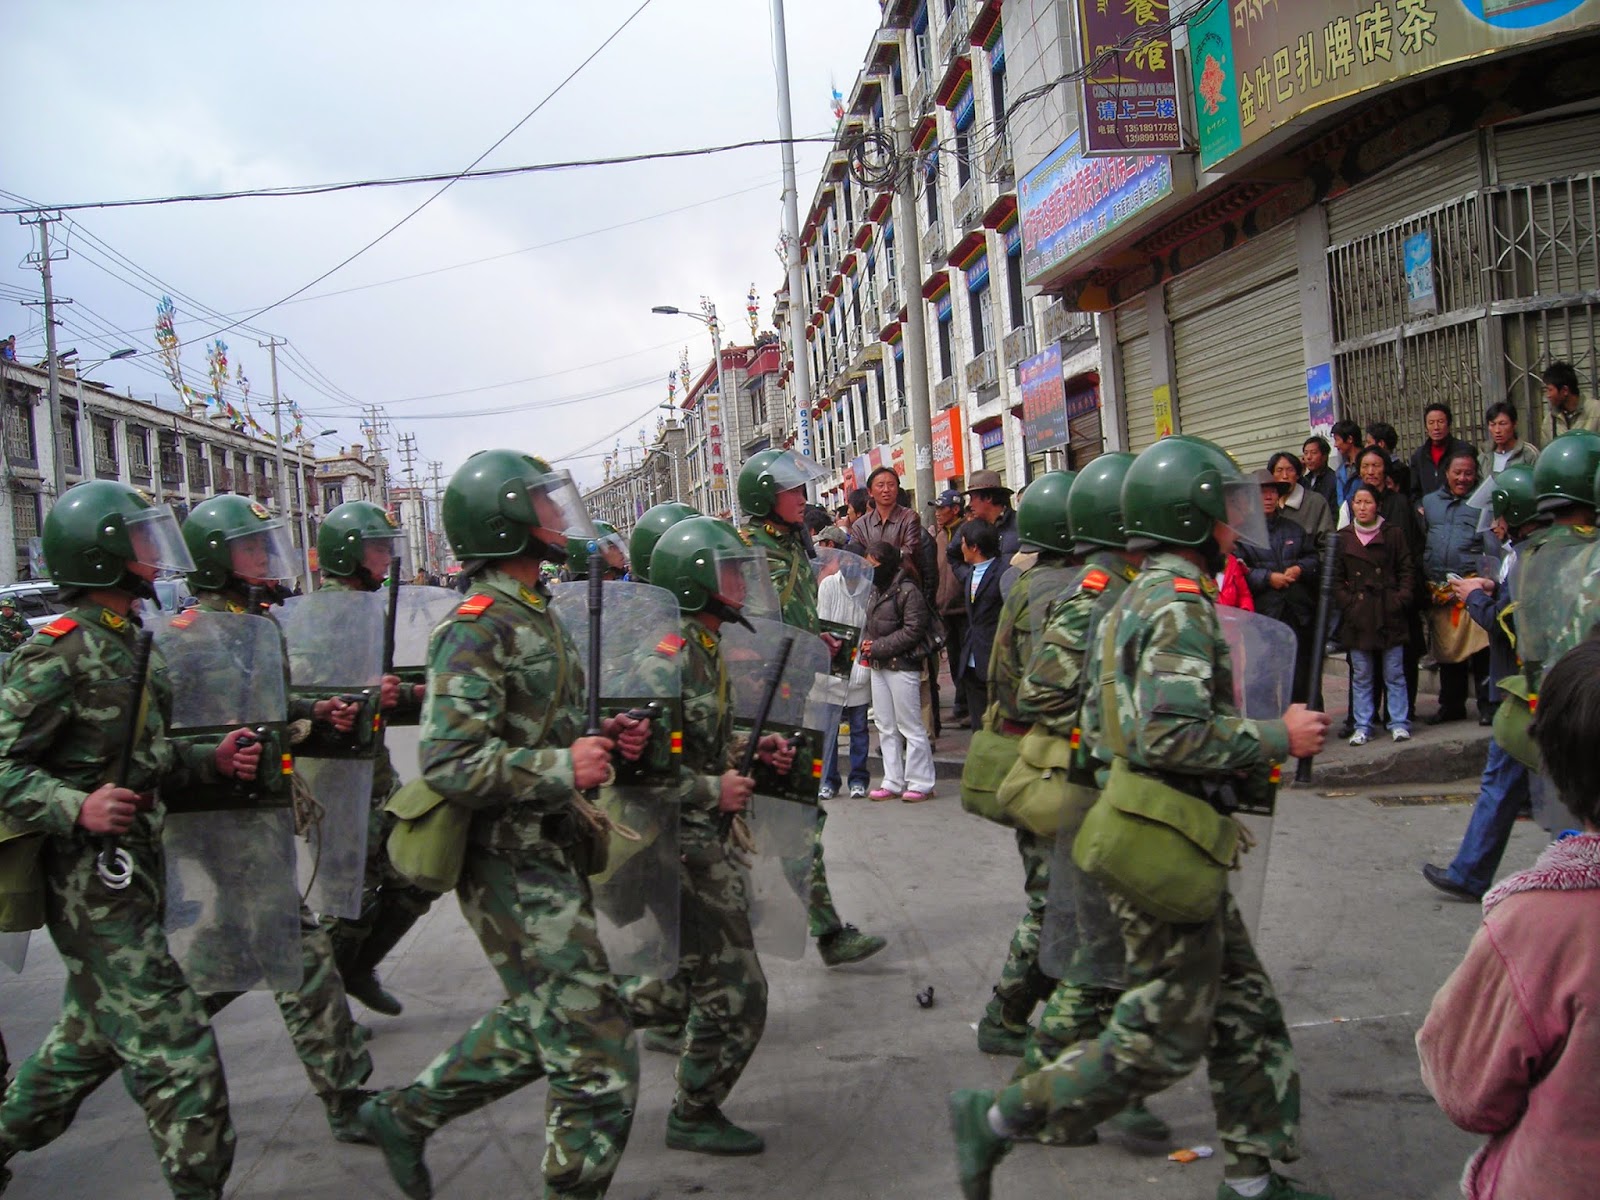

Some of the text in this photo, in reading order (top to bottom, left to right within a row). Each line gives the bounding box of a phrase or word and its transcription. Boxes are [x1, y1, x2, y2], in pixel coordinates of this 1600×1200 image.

[1239, 0, 1437, 128] 金叶巴扎牌砖茶
[1097, 98, 1176, 120] 请上二楼
[800, 409, 810, 456] 62130
